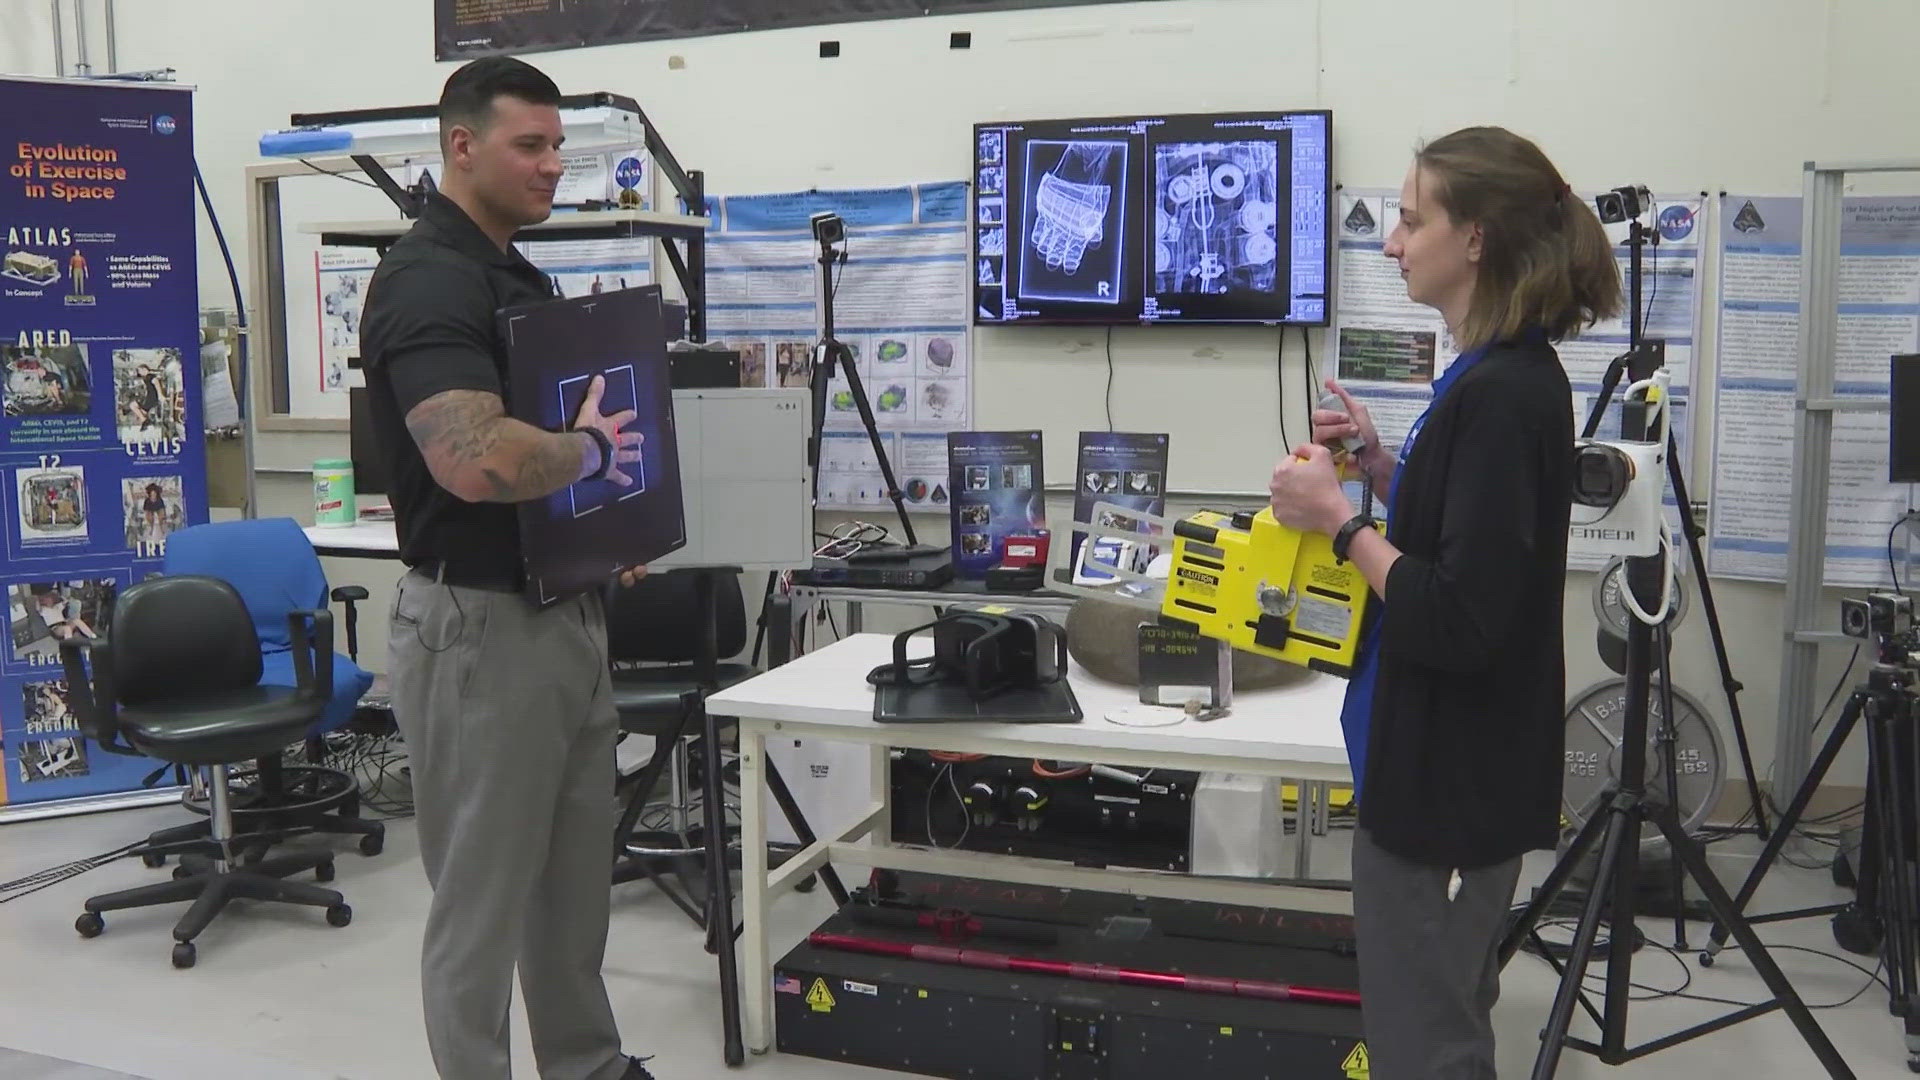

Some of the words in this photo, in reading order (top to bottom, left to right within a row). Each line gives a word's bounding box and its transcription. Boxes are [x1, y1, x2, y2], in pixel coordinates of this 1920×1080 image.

[19, 142, 117, 162] Evolution
[10, 160, 33, 178] of
[39, 162, 126, 180] Exercise
[25, 181, 45, 198] in
[51, 181, 115, 202] Space
[1661, 219, 1692, 228] NASA
[8, 227, 71, 246] ATLAS
[1098, 281, 1110, 296] R
[18, 329, 71, 349] ARED
[126, 437, 181, 456] CEVIS
[39, 454, 61, 472] T2
[137, 539, 166, 557] IRE
[1181, 569, 1214, 584] CAUTION
[1677, 749, 1700, 761] 45
